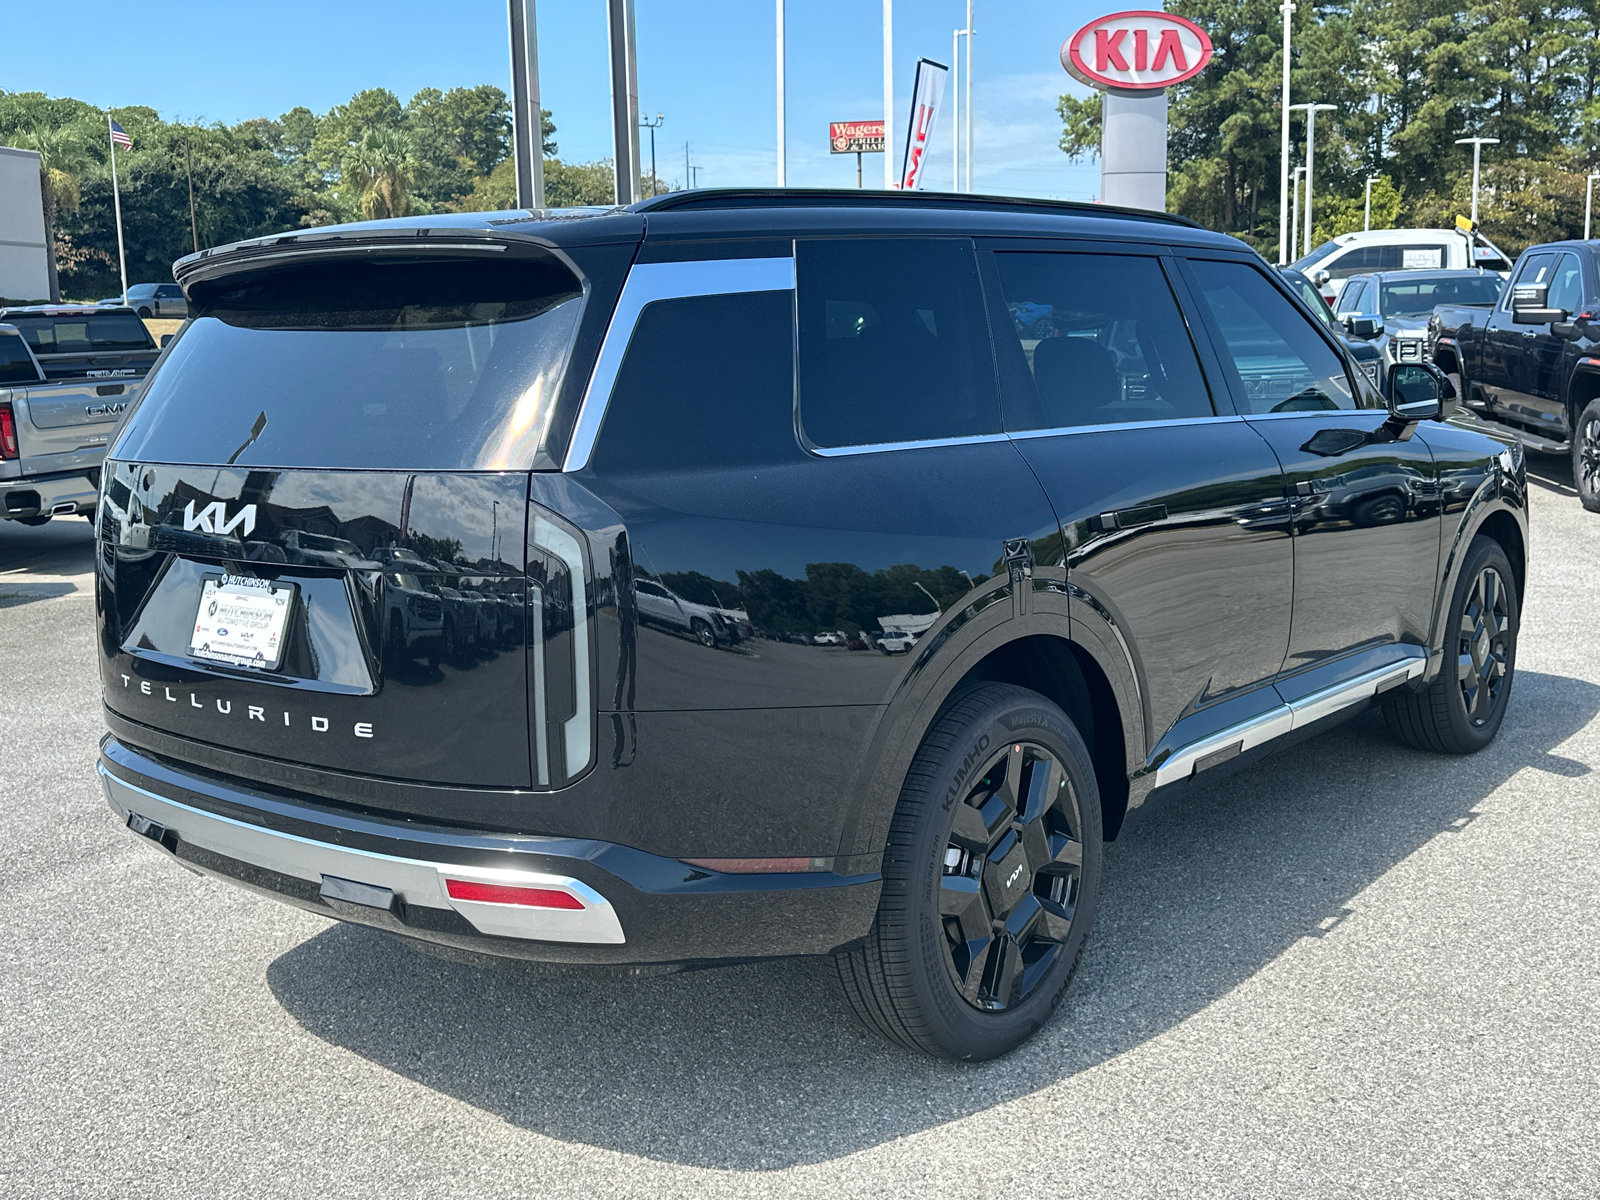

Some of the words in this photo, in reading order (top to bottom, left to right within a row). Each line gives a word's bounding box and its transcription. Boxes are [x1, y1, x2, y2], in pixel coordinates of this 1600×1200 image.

[1094, 29, 1189, 71] KIA
[85, 403, 128, 418] GM
[228, 576, 270, 588] HUTCHINSON
[218, 604, 275, 621] HUTCHINSON
[217, 617, 250, 628] AUTOMOTIVE
[250, 621, 270, 629] GROUP
[121, 673, 374, 738] TELLURIDE
[941, 733, 991, 813] KUMHO
